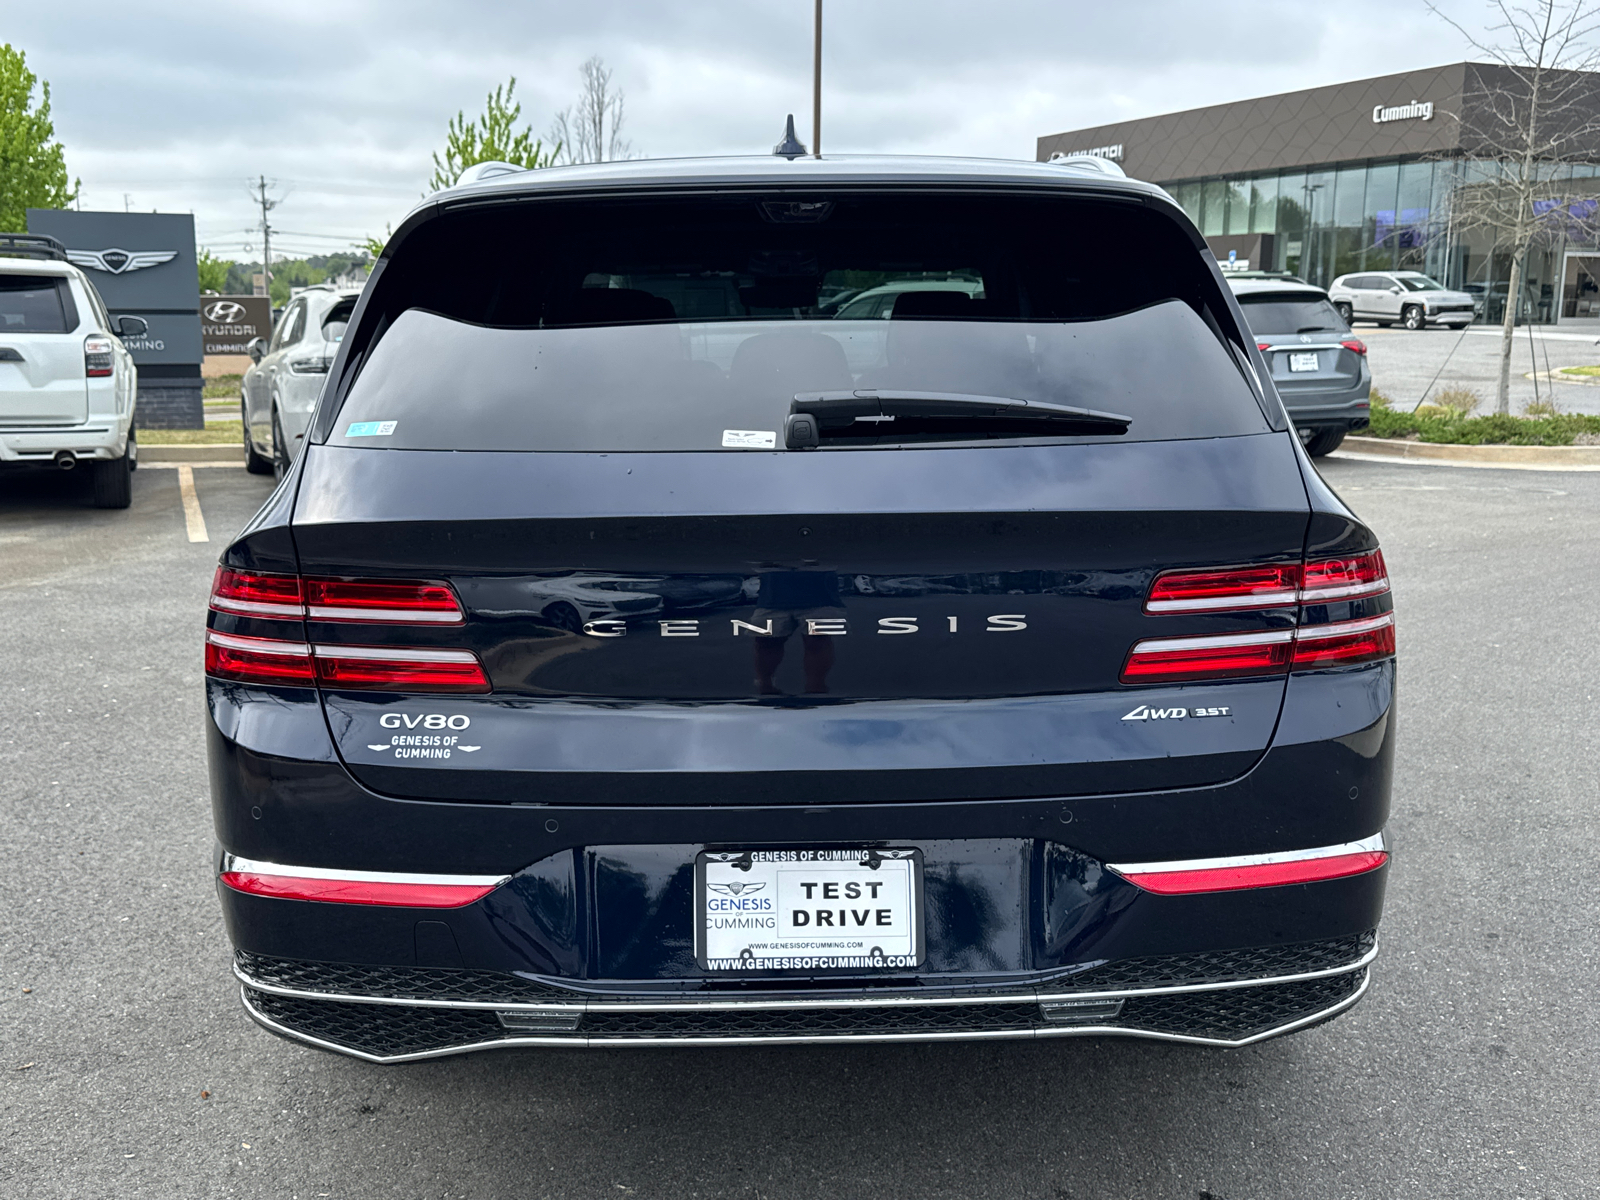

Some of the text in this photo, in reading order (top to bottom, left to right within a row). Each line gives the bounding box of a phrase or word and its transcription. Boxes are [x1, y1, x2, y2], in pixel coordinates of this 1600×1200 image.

[1373, 100, 1433, 123] Cumming
[582, 614, 1028, 637] GENESIS
[1120, 705, 1230, 720] 4WD 3.5T
[379, 713, 471, 730] GV80
[391, 735, 458, 746] GENESIS OF
[395, 748, 451, 759] CUMMING
[750, 850, 870, 862] GENESIS OF CUMMING
[800, 881, 883, 900] TEST
[708, 898, 771, 911] GENESIS
[706, 917, 775, 929] CUMMING
[792, 909, 892, 927] DRIVE
[748, 941, 864, 950] WWW.GENESISOFCUMMING.COM
[707, 955, 917, 971] WWW.GENESISOFCUMMING.COM
